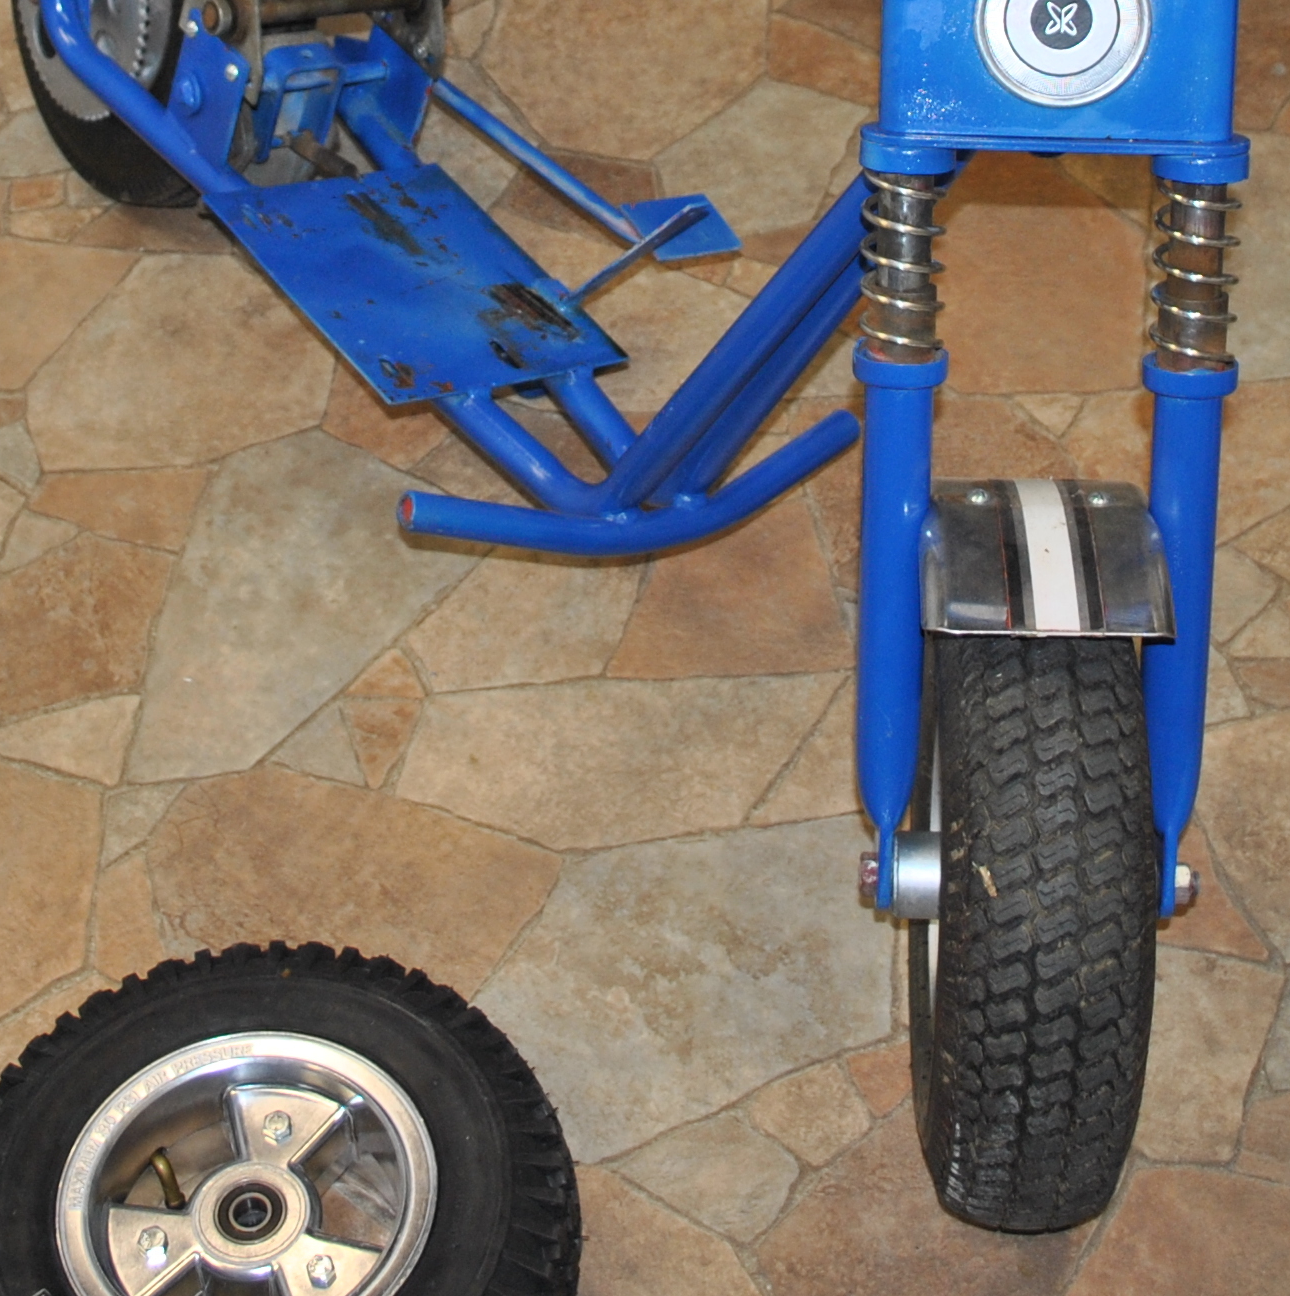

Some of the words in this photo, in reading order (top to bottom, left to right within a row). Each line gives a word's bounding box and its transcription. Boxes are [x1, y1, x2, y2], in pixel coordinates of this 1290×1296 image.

[117, 1090, 142, 1115] PSI
[144, 1070, 170, 1093] AIR
[171, 1044, 254, 1074] PRESSURE
